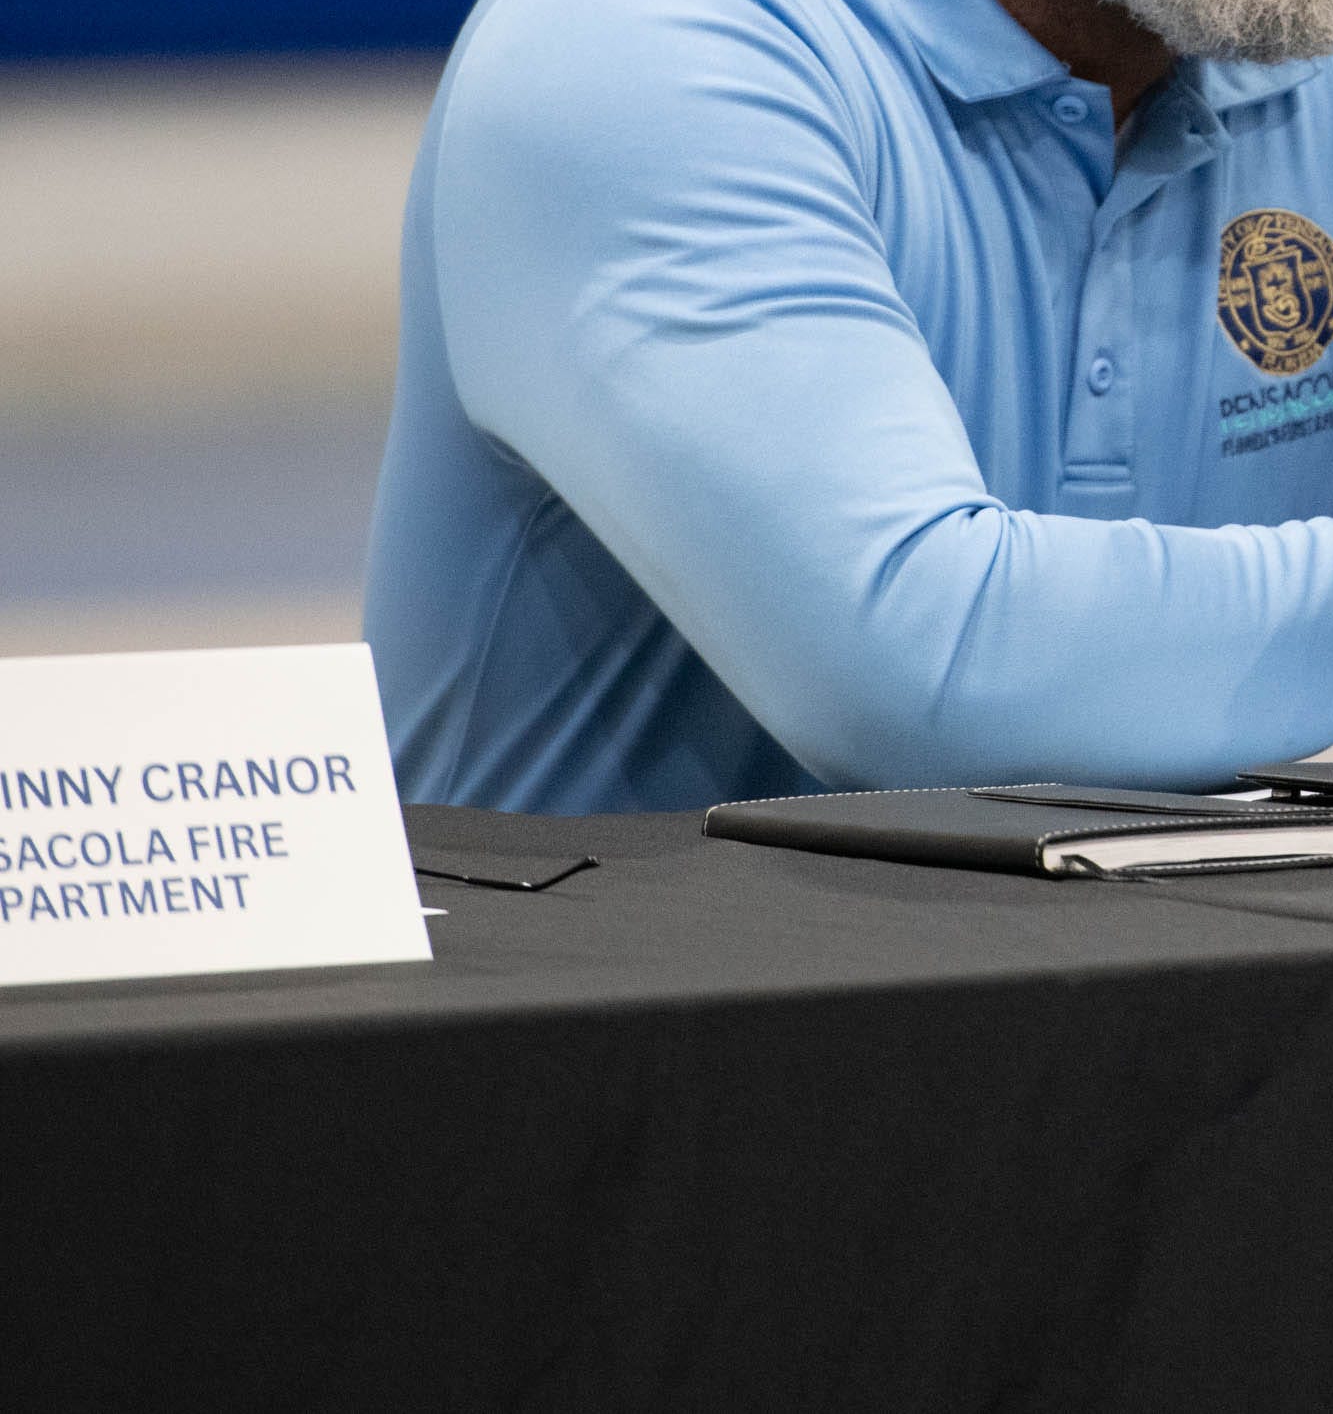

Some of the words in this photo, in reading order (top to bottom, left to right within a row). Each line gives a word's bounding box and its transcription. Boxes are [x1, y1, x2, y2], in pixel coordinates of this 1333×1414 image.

[142, 755, 355, 802] CRANOR
[188, 823, 288, 861] FIRE
[0, 874, 249, 922] PARTMENT
